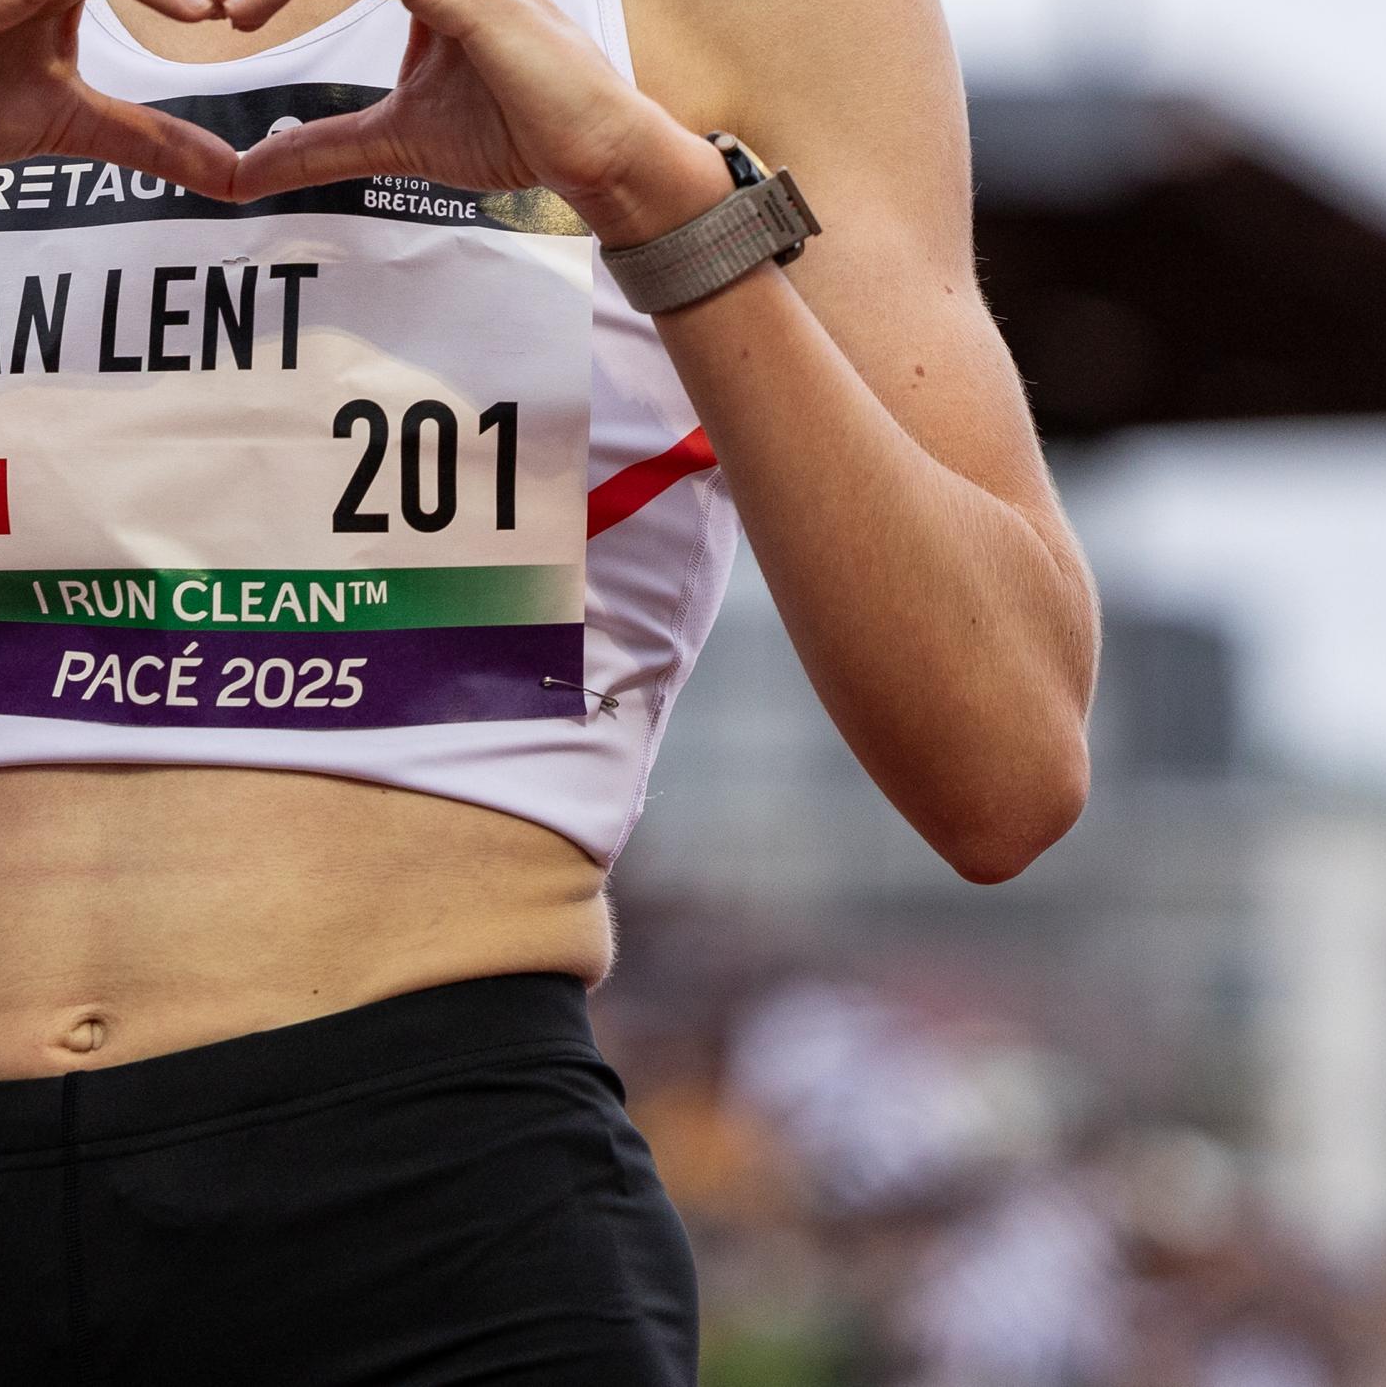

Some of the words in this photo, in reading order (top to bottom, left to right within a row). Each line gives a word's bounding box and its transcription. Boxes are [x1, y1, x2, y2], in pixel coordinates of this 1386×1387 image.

[98, 263, 319, 372] LENT
[332, 398, 518, 533] 201
[32, 580, 49, 614] I
[58, 580, 156, 620] RUN
[52, 641, 204, 706] PACÉ
[216, 657, 368, 708] 2025
